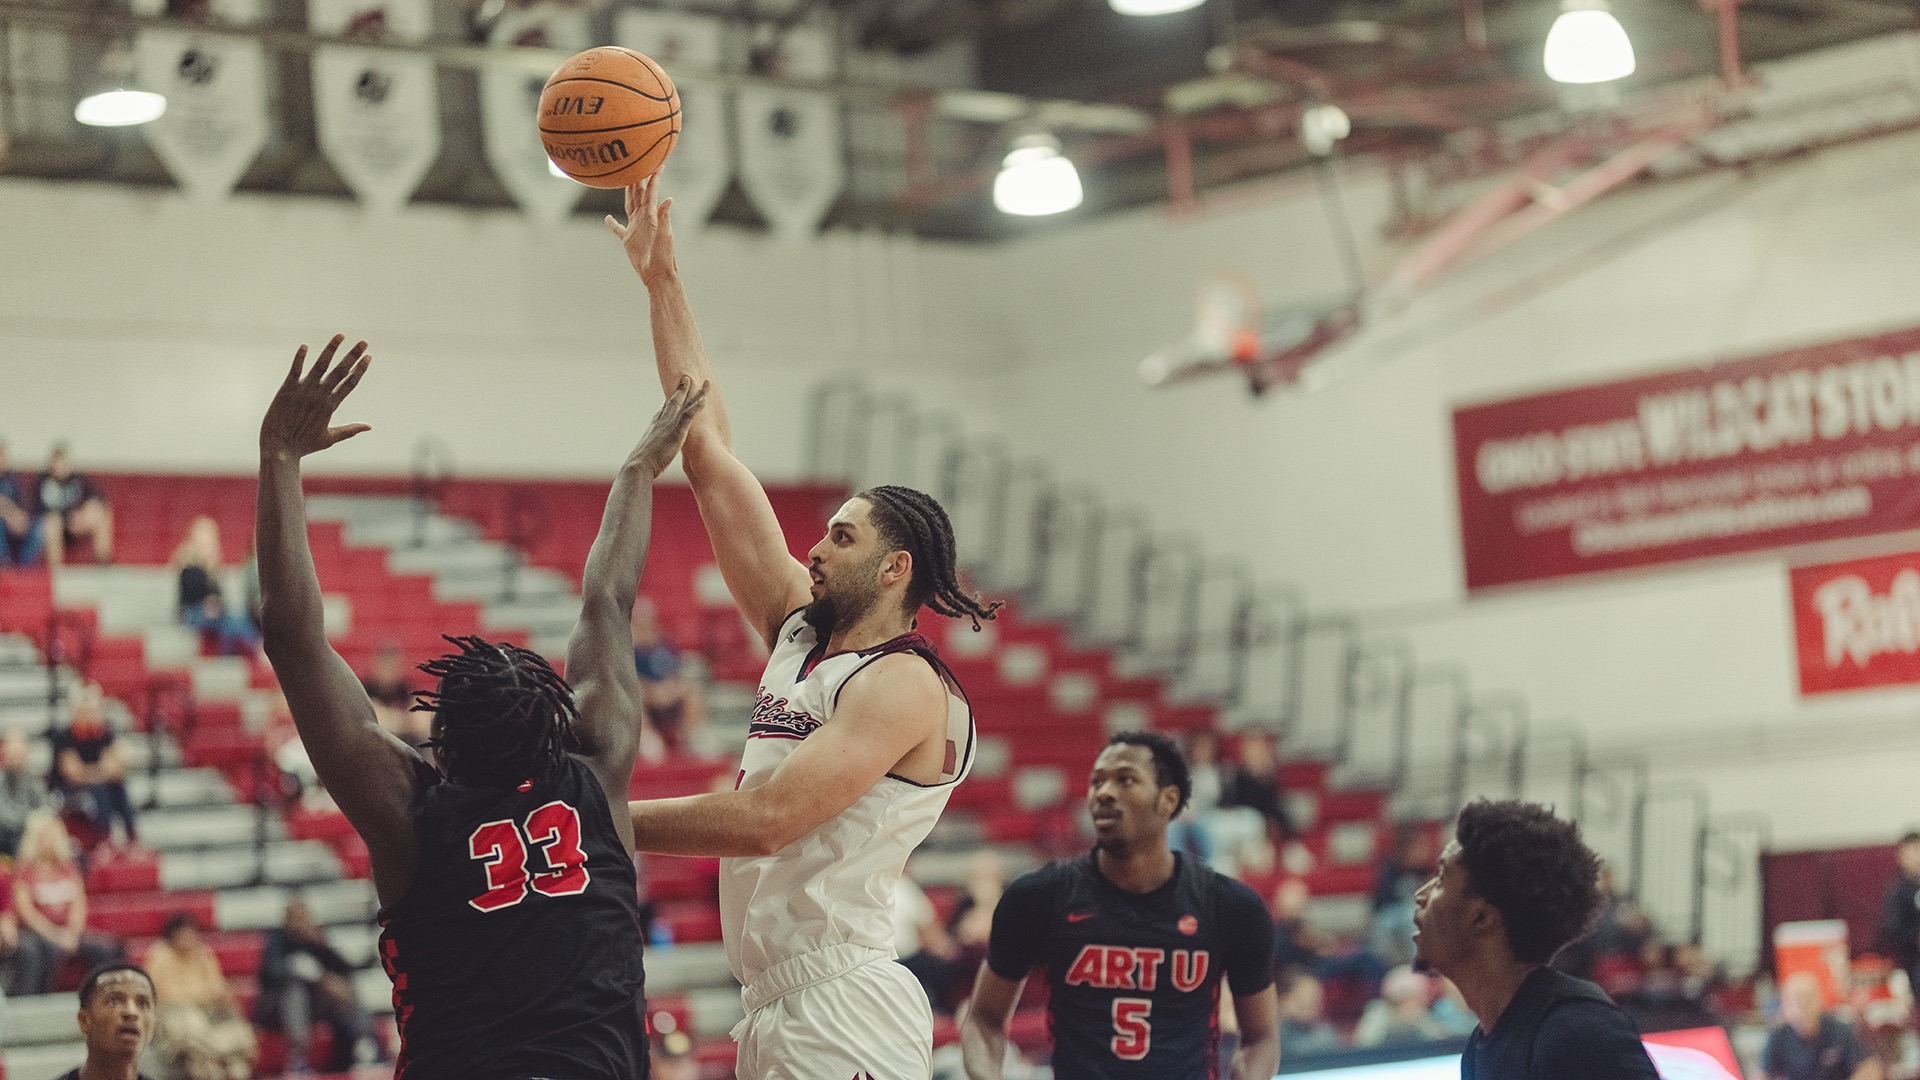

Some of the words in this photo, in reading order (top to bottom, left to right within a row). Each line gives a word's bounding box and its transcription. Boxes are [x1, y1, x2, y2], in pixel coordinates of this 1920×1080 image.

[552, 96, 605, 116] EVO
[468, 799, 591, 914] 33
[1065, 944, 1165, 992] ART
[1171, 949, 1209, 993] U
[1111, 997, 1152, 1061] 5
